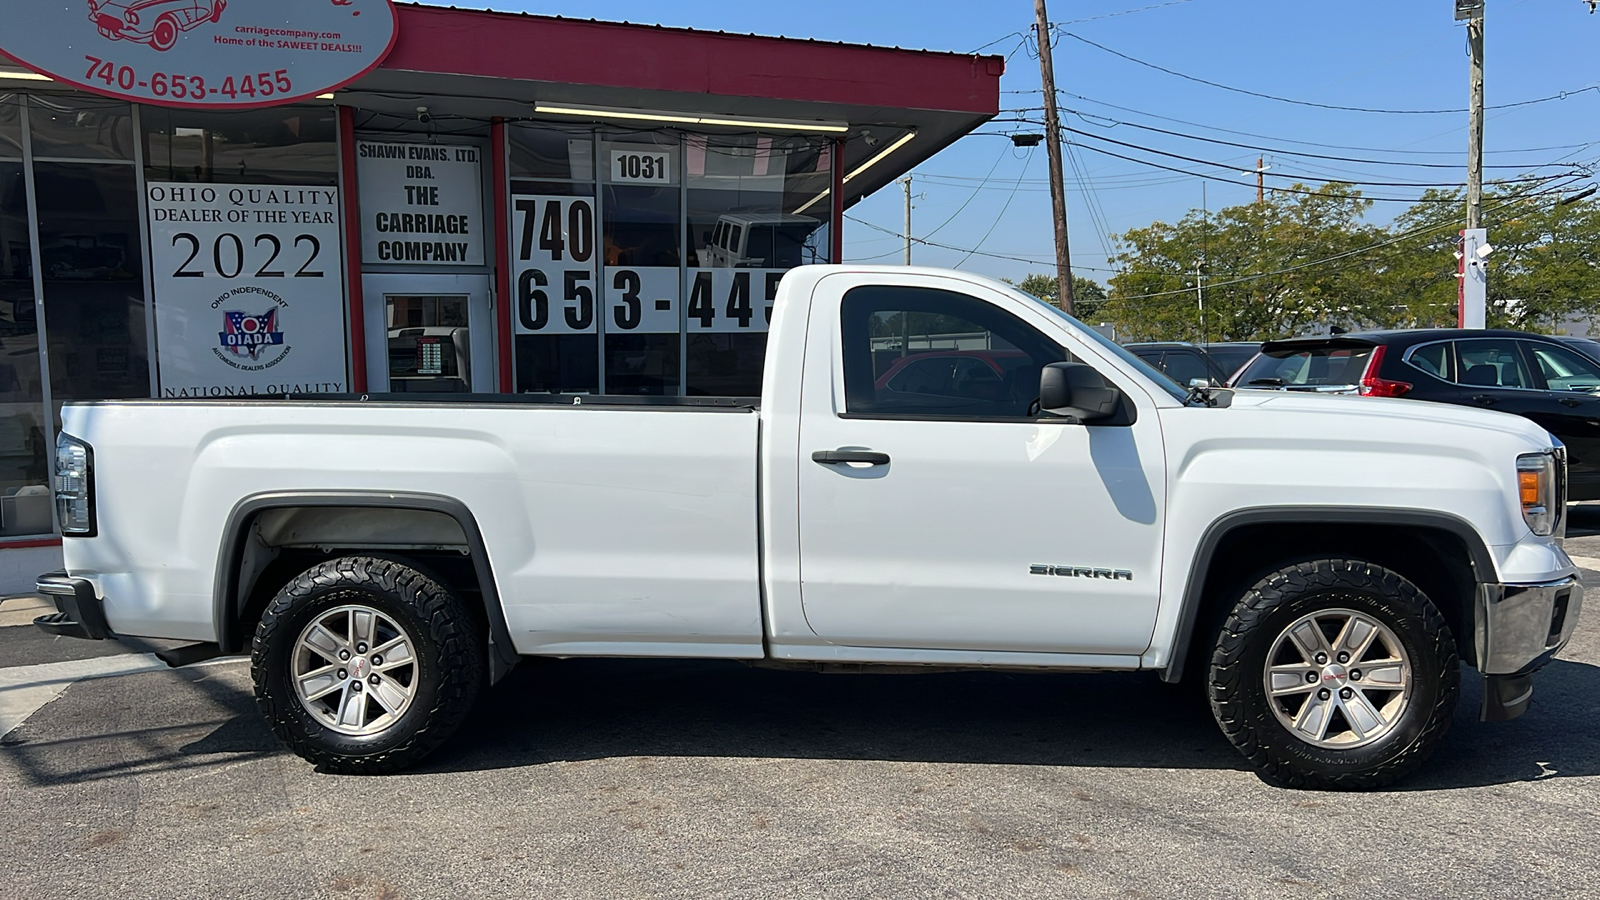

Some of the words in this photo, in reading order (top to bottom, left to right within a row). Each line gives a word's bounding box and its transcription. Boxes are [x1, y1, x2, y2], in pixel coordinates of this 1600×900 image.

[235, 25, 341, 40] carriagecompany.com
[214, 35, 244, 45] Home
[245, 38, 256, 46] of
[258, 38, 275, 48] the
[277, 40, 319, 51] SAWEET
[321, 43, 362, 53] DEALS!!!
[83, 55, 292, 100] 740-653-4455
[360, 144, 405, 159] SHAWN
[408, 146, 451, 161] EVANS.
[455, 149, 479, 163] LTD.
[406, 165, 435, 179] DBA.
[617, 155, 664, 179] 1031
[150, 187, 216, 202] OHIO
[228, 189, 336, 206] QUALITY
[404, 185, 439, 206] THE
[154, 208, 223, 222] DEALER
[227, 210, 249, 222] OF
[253, 210, 287, 223] THE
[291, 211, 335, 224] YEAR
[376, 212, 469, 234] CARRIAGE
[516, 200, 593, 262] 740
[172, 232, 324, 279] 2022
[378, 240, 469, 262] COMPANY
[211, 292, 231, 309] OHIO
[230, 286, 289, 309] INDEPENDENT
[227, 333, 273, 345] OIADA
[212, 347, 240, 370] AUTOMOBILE
[265, 345, 292, 369] ASSOCIATION
[165, 385, 259, 397] NATIONAL
[266, 382, 342, 394] QUALITY
[1030, 563, 1133, 581] SIERRA
[1323, 673, 1346, 681] GMC
